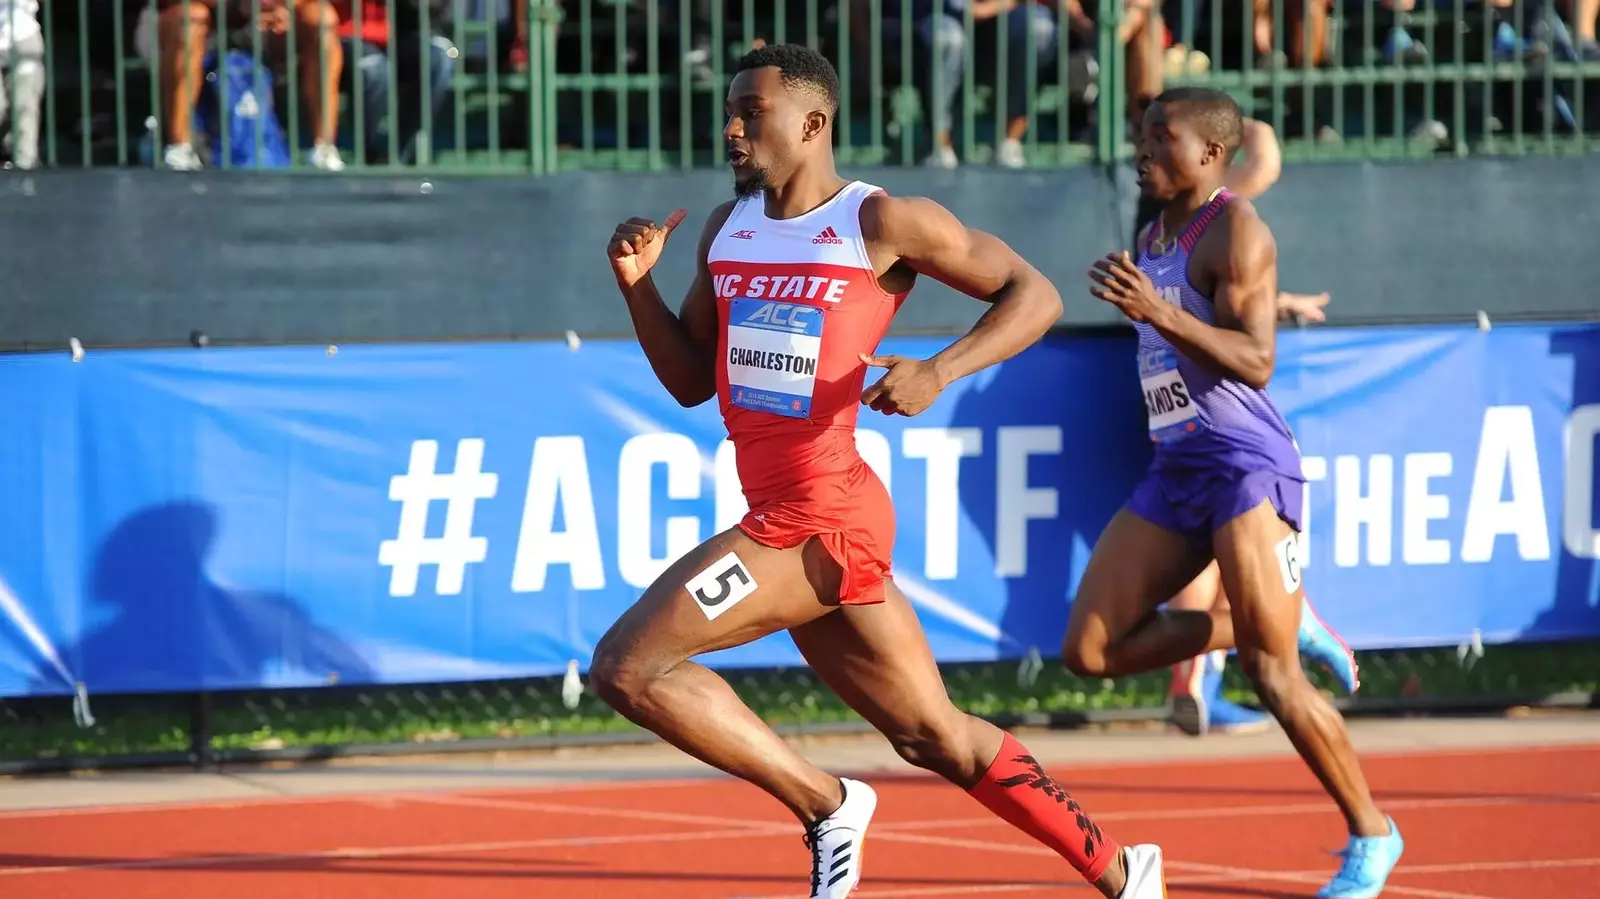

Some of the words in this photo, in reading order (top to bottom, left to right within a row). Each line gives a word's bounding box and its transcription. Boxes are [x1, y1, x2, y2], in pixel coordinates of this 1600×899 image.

[730, 230, 756, 239] ACC
[713, 274, 742, 298] NC
[745, 276, 850, 303] STATE
[743, 303, 817, 330] ACC
[729, 347, 816, 376] CHARLESTON
[695, 563, 750, 607] 5
